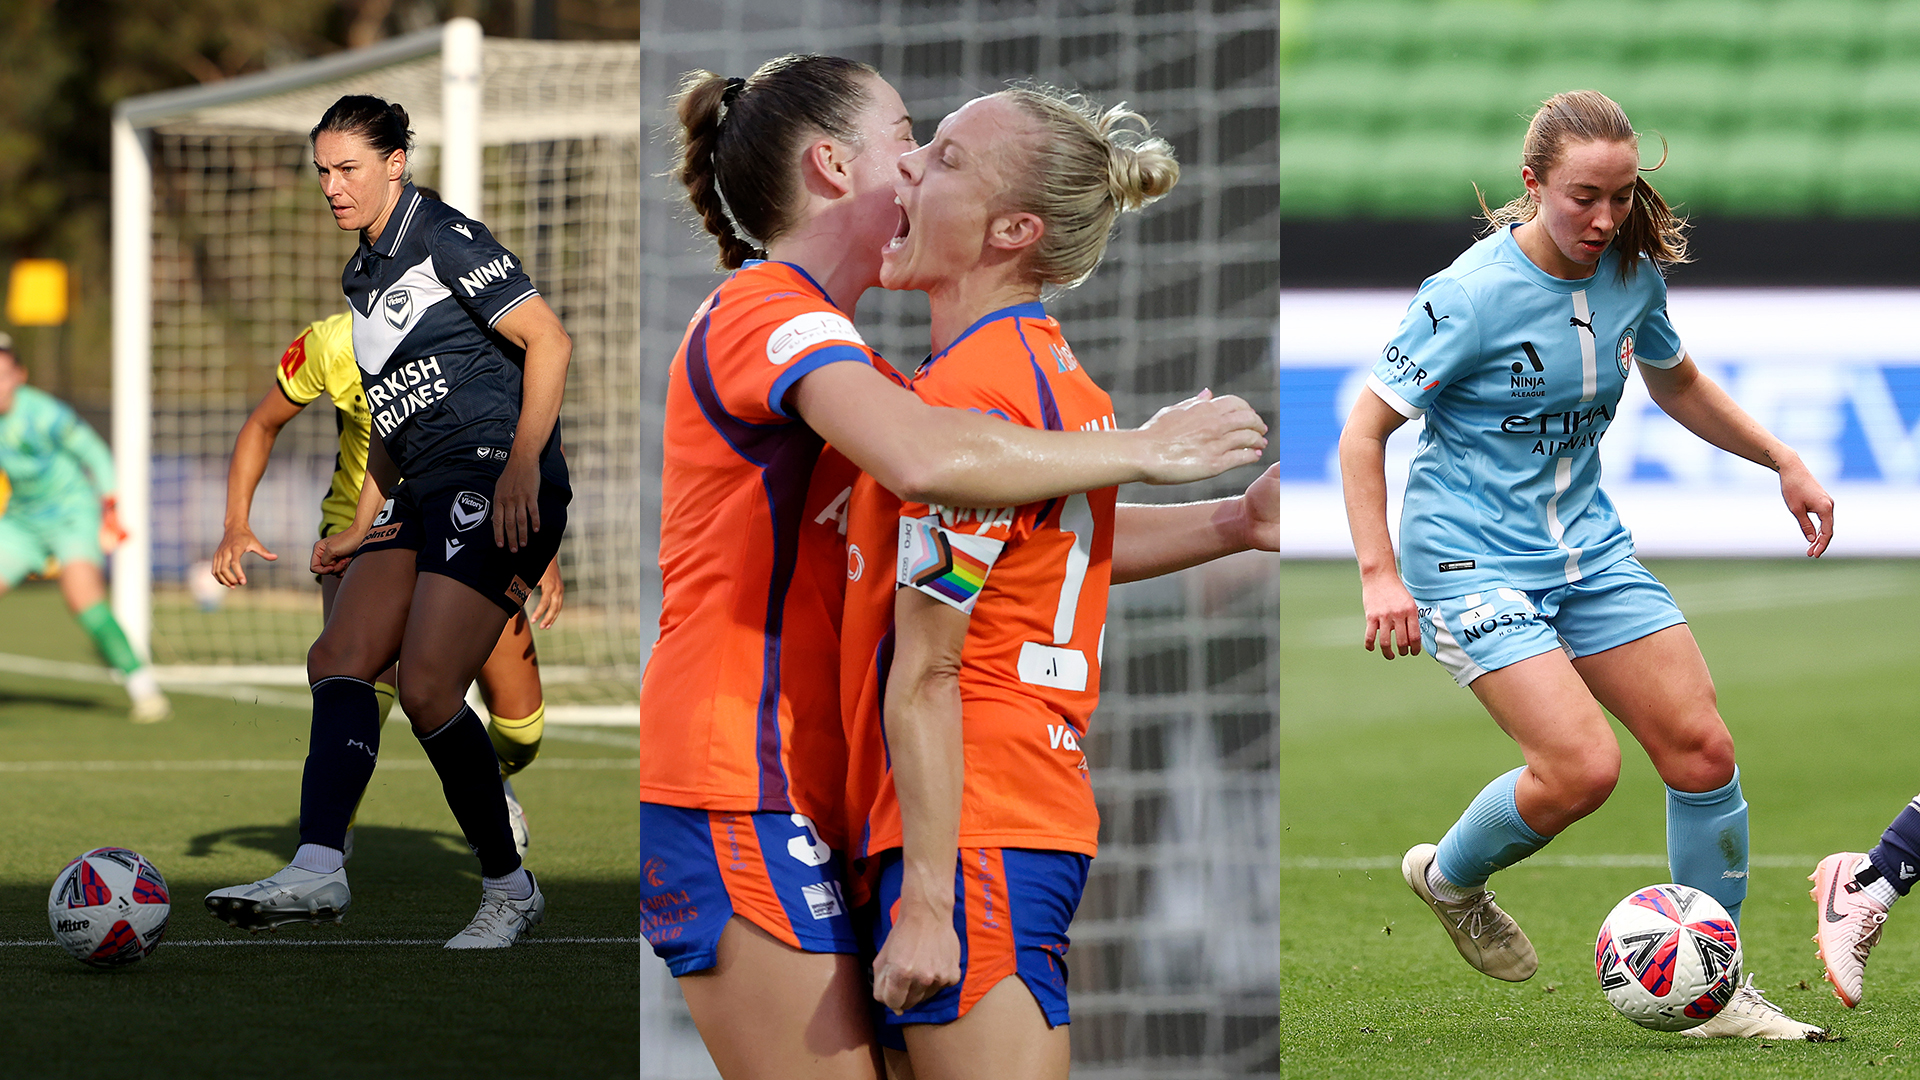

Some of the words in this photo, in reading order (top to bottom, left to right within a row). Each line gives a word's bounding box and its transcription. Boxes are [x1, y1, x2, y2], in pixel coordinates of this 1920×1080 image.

[458, 255, 515, 297] NINJA
[1510, 375, 1545, 390] NINJA
[494, 450, 508, 459] 20
[461, 496, 484, 510] Victory
[727, 825, 741, 861] ROAR
[983, 883, 994, 920] ROAR
[57, 919, 89, 933] Mitre
